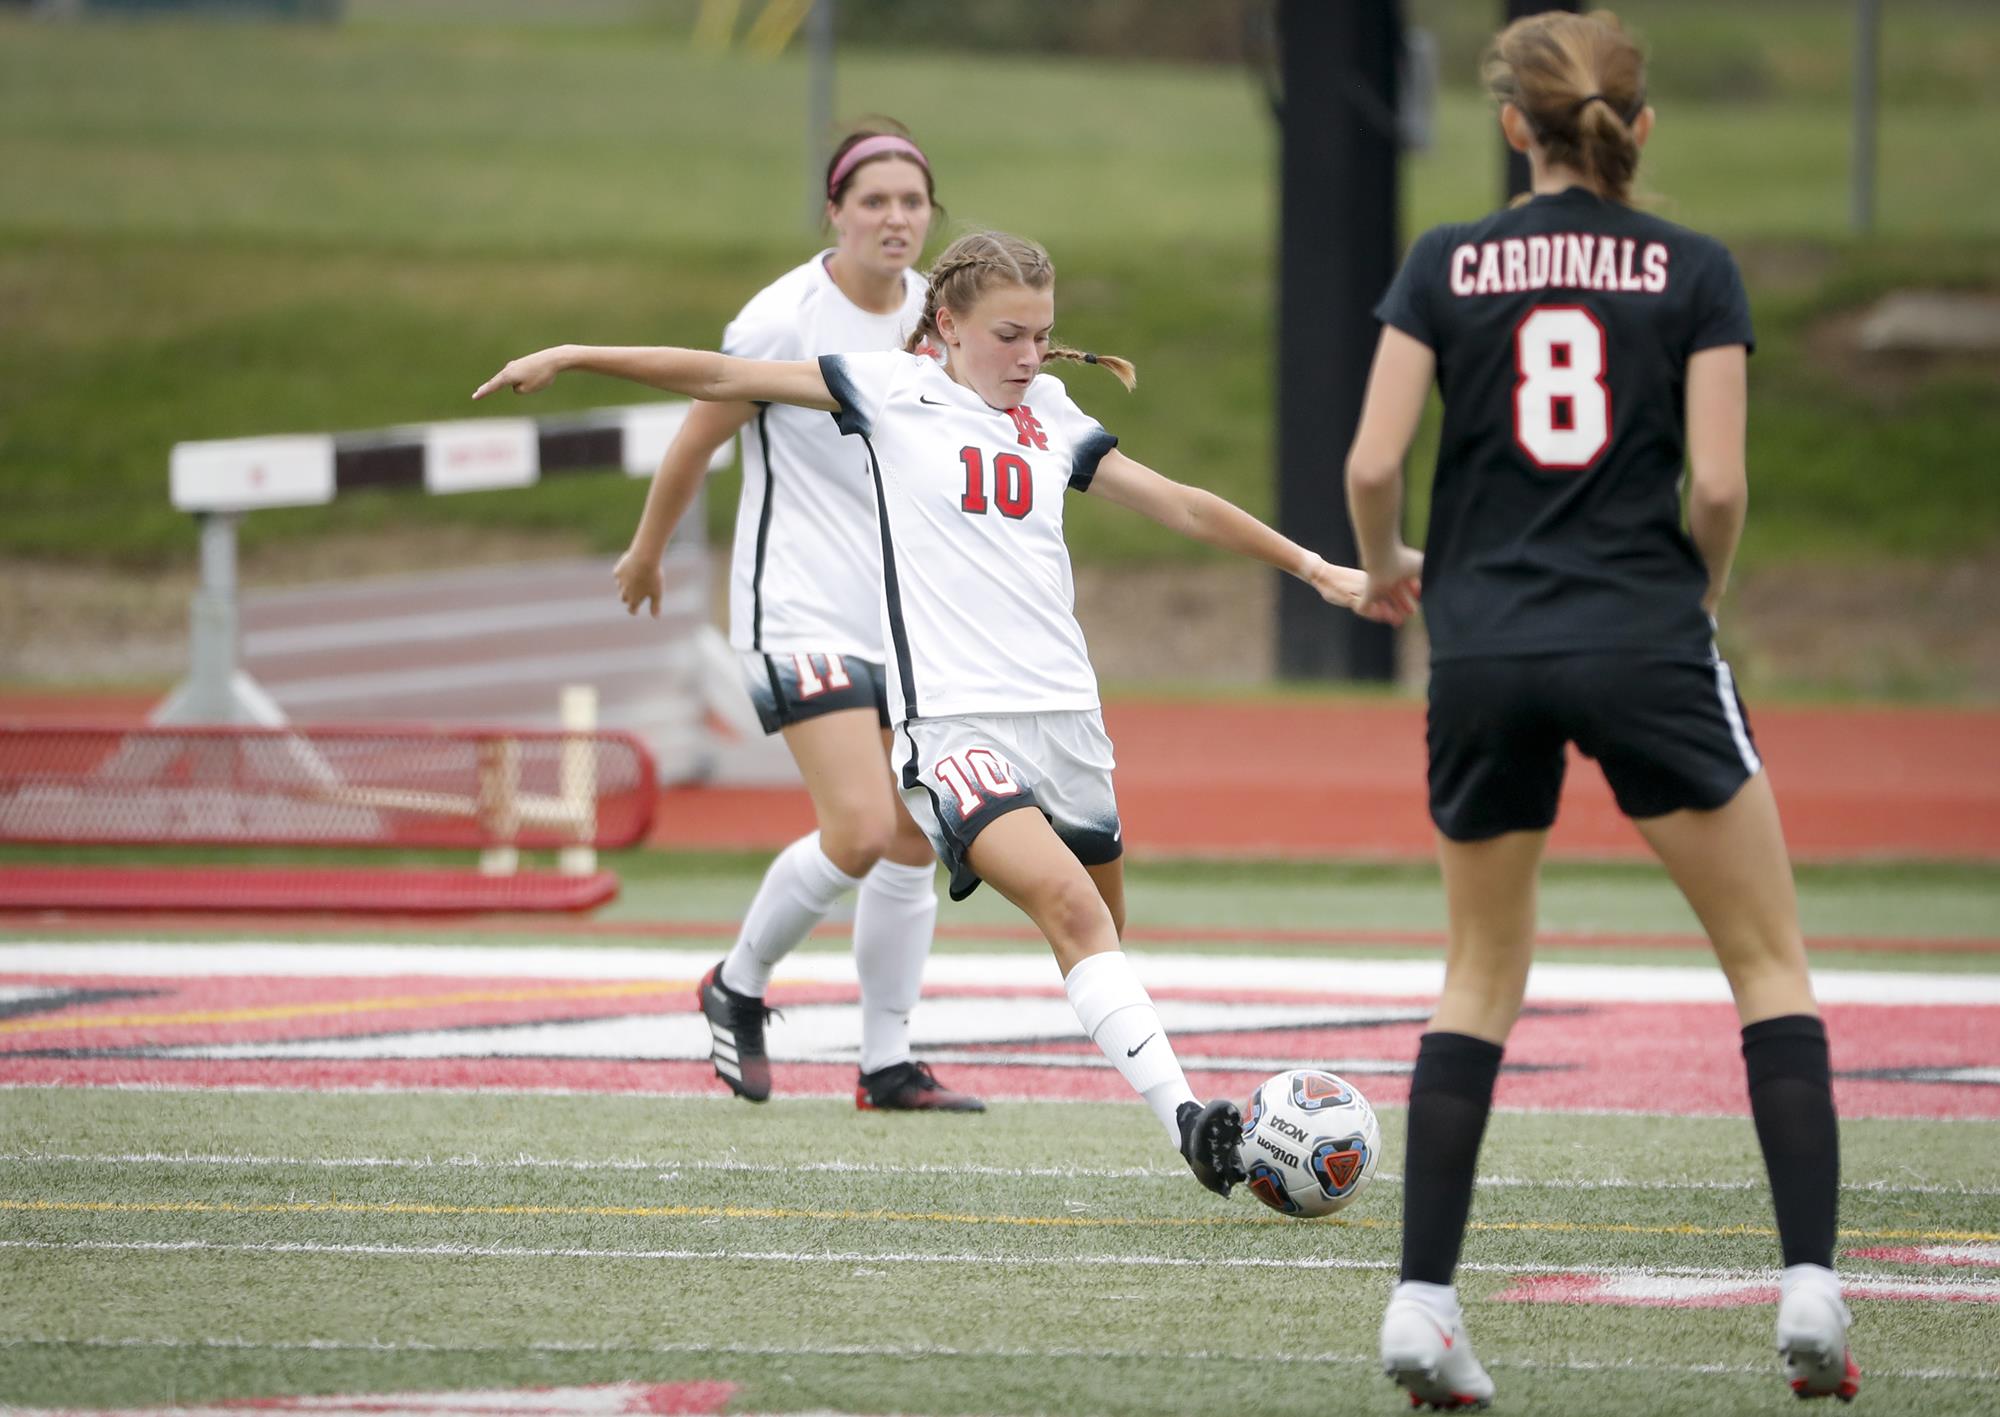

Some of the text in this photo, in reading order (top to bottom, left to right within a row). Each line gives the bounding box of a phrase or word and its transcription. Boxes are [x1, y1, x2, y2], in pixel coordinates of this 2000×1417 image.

[1450, 232, 1670, 297] CARDINALS
[1512, 304, 1614, 471] 8
[959, 445, 1034, 521] 10
[934, 748, 1021, 820] 10
[1257, 1136, 1299, 1169] Wilson
[1270, 1115, 1308, 1142] NCAA
